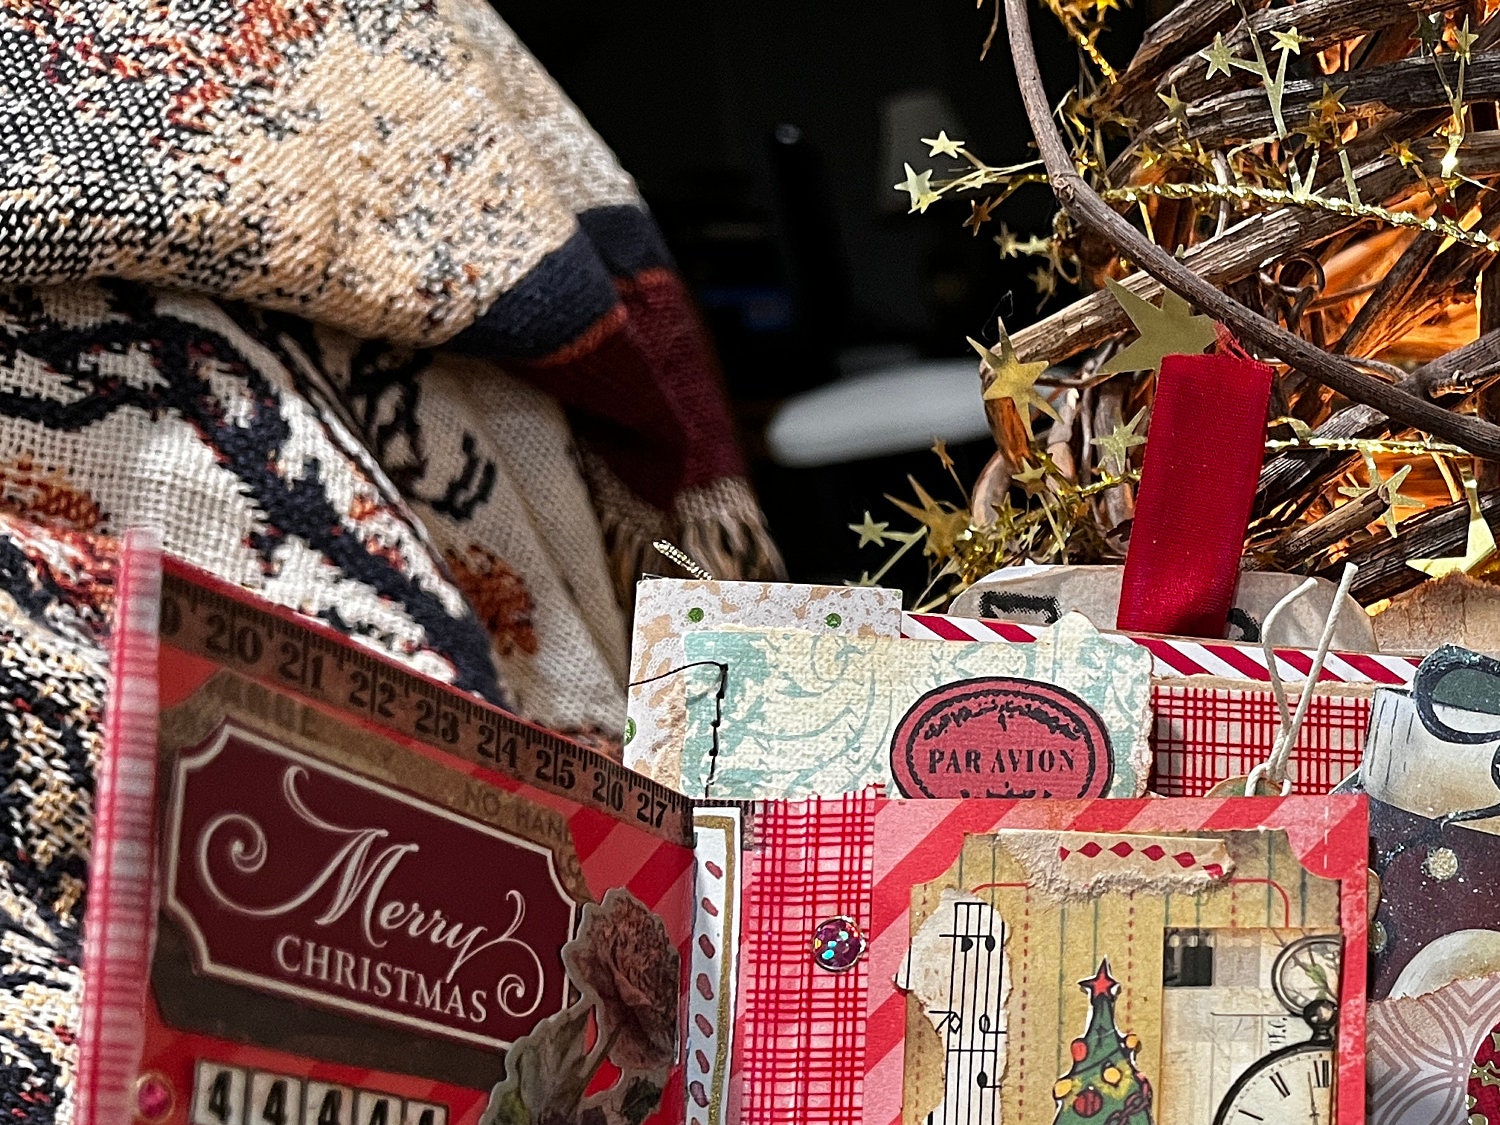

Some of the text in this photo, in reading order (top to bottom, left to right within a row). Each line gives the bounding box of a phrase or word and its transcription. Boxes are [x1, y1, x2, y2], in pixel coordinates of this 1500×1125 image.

[928, 748, 1075, 775] PAR AVION
[275, 934, 489, 1024] CHRISTMAS
